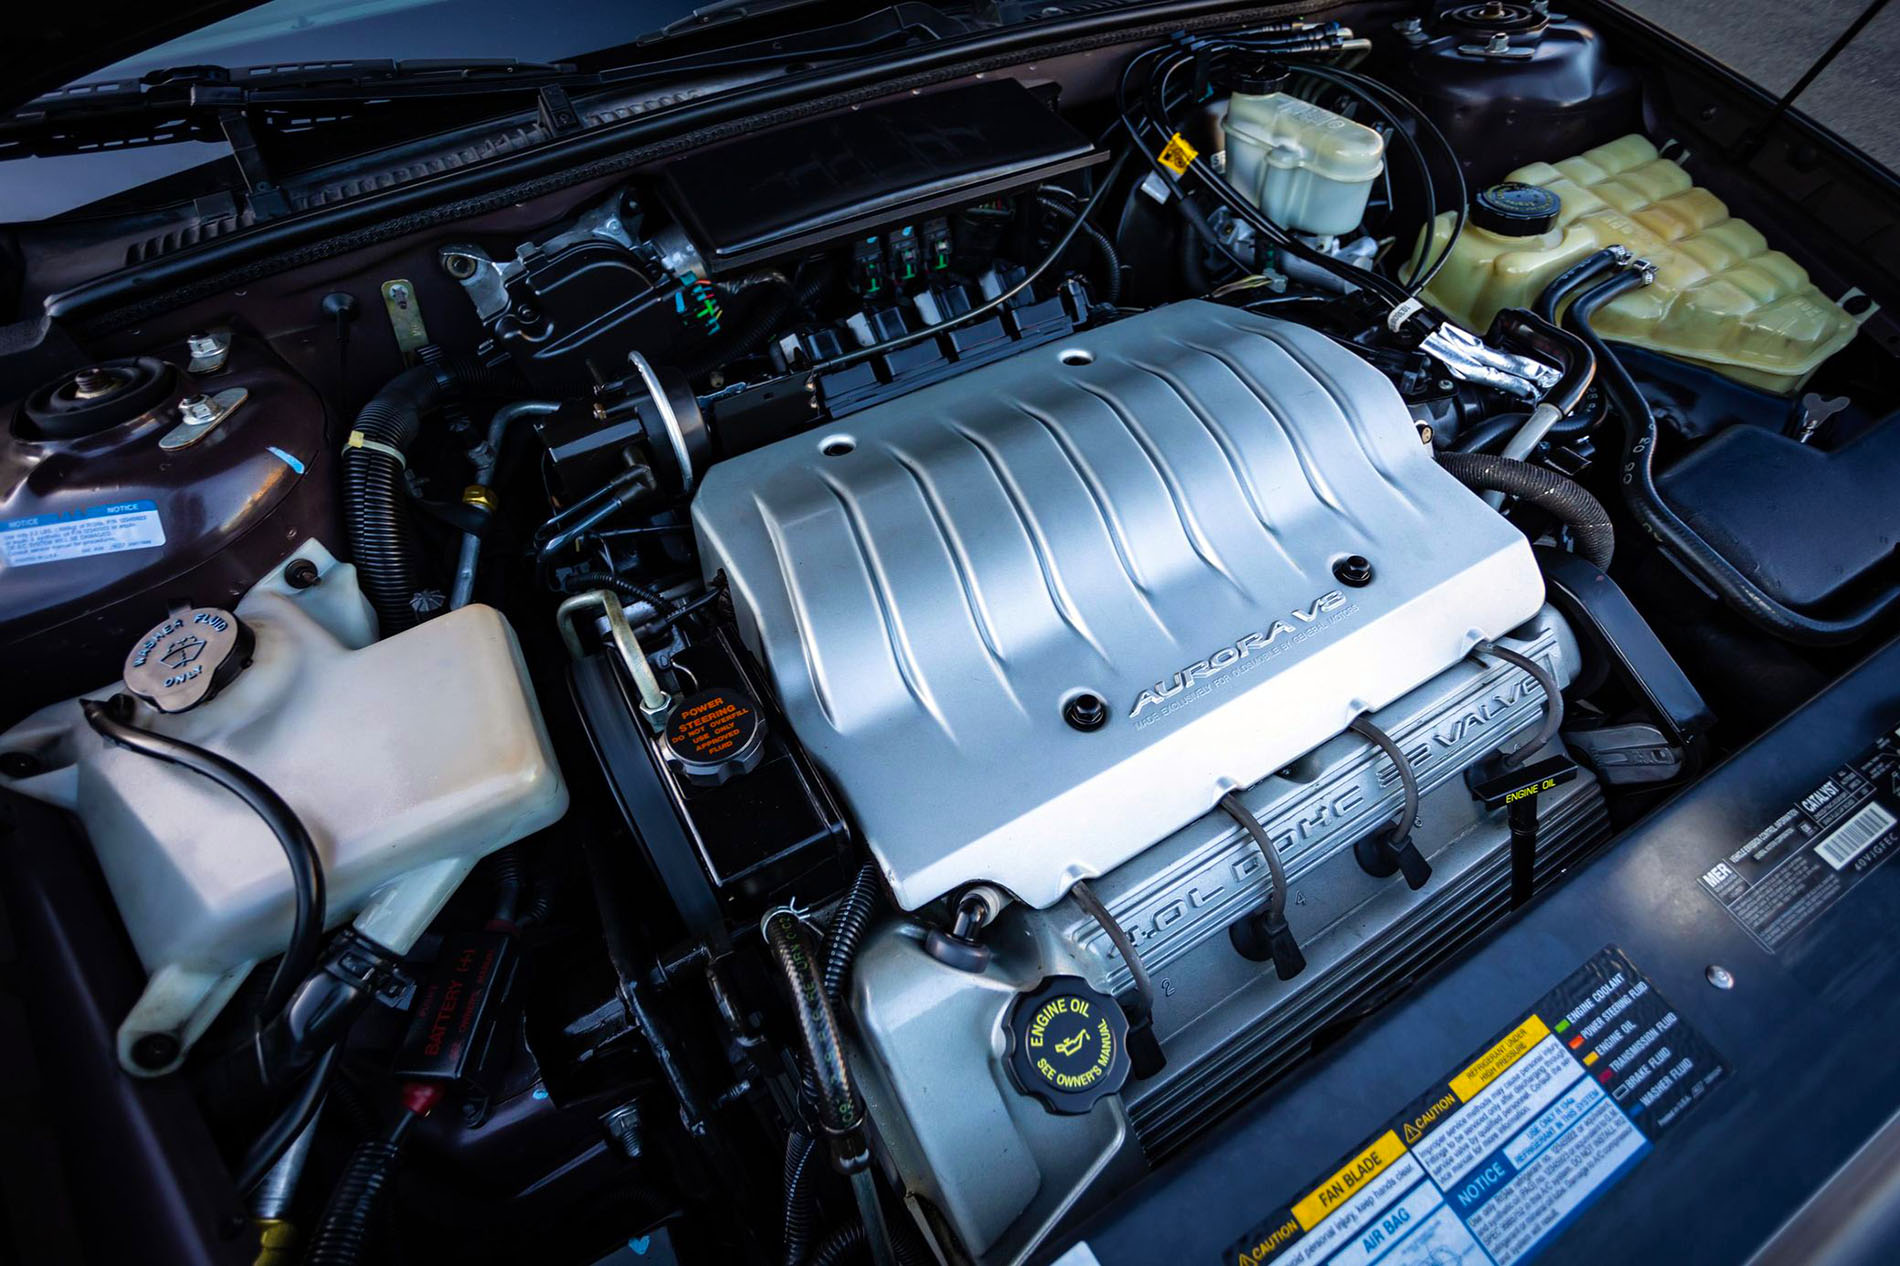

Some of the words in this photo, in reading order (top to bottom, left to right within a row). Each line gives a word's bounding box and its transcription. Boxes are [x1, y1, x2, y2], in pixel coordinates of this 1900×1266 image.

[8, 517, 38, 528] NOTICE
[106, 503, 138, 513] NOTICE
[133, 619, 184, 668] WASHER
[194, 613, 228, 632] FLUID
[1129, 619, 1297, 719] AURORA
[1292, 590, 1347, 623] V8
[164, 665, 202, 687] ONLY
[1135, 712, 1161, 732] MADE
[1160, 683, 1211, 717] EXCLUSIVELY
[1214, 674, 1230, 690] FOR
[1233, 647, 1281, 678] OLDSMOBILE
[1280, 639, 1293, 651] BY
[1293, 623, 1328, 646] GENERAL
[1328, 604, 1360, 627] MOTORS
[672, 735, 685, 743] DO
[688, 726, 705, 737] NOT
[710, 708, 749, 728] OVERFILL
[679, 705, 736, 732] STEERING
[681, 698, 723, 719] POWER
[693, 733, 710, 744] USE
[714, 722, 735, 734] ONLY
[696, 729, 740, 751] APPROVED
[709, 740, 733, 755] FLUID
[1505, 784, 1538, 804] ENGINE
[1542, 778, 1556, 790] OIL
[1801, 780, 1839, 812] CATALYST
[1232, 785, 1365, 882] DOHC
[1702, 860, 1733, 889] MER
[1295, 889, 1307, 906] 4
[1161, 978, 1176, 997] 2
[1565, 998, 1595, 1024] ENGINE
[1591, 971, 1626, 1002] COOLANT
[1580, 1016, 1605, 1040] POWER
[1601, 993, 1632, 1022] STEERING
[1627, 979, 1648, 999] FLUID
[422, 978, 465, 1059] BATTERY
[1030, 998, 1067, 1047] ENGINE
[1070, 998, 1090, 1018] OIL
[1594, 1029, 1624, 1056] ENGINE
[1619, 1017, 1636, 1034] OIL
[1037, 1058, 1057, 1081] SEE
[1056, 1065, 1102, 1088] OWNER'S
[1097, 1018, 1112, 1067] MANUAL
[1465, 1043, 1507, 1080] REFRIGERANT
[1504, 1027, 1527, 1047] UNDER
[1478, 1064, 1497, 1082] HIGH
[1494, 1040, 1527, 1069] PRESSURE
[1608, 1027, 1659, 1073] TRANSMISSION
[1655, 1011, 1677, 1032] FLUID
[1624, 1063, 1651, 1089] BRAKE
[1647, 1045, 1671, 1068] FLUID
[1638, 1074, 1673, 1107] WASHER
[1668, 1056, 1694, 1080] FLUID
[1413, 1092, 1456, 1130] CAUTION
[1417, 1132, 1448, 1160] Improper
[1444, 1116, 1467, 1137] service
[1464, 1095, 1492, 1120] methods
[1490, 1087, 1506, 1102] may
[1503, 1072, 1521, 1089] cause
[1518, 1052, 1545, 1077] personal
[1424, 1145, 1449, 1168] Fittings
[1446, 1139, 1455, 1149] to
[1453, 1132, 1464, 1143] be
[1461, 1111, 1488, 1136] serviced
[1485, 1101, 1502, 1117] only
[1498, 1090, 1514, 1105] after
[1512, 1064, 1547, 1095] discharging
[1543, 1047, 1567, 1069] through
[1432, 1155, 1455, 1176] service
[1453, 1142, 1470, 1158] valve
[1468, 1134, 1480, 1147] by
[1476, 1113, 1504, 1139] qualified
[1501, 1090, 1532, 1118] personnel.
[1529, 1071, 1552, 1092] Consult
[1549, 1063, 1561, 1075] the
[1512, 1125, 1557, 1165] REFRIGERANT
[1553, 1119, 1564, 1129] IN
[1561, 1107, 1577, 1123] THIS
[1574, 1087, 1600, 1111] SYSTEM
[1525, 1125, 1541, 1140] USE
[1538, 1111, 1557, 1128] ONLY
[1438, 1171, 1452, 1184] vice
[1450, 1151, 1474, 1173] manual
[1471, 1143, 1483, 1155] for
[1481, 1131, 1499, 1147] more
[1496, 1104, 1530, 1134] information.
[1579, 1143, 1595, 1158] NOT
[1316, 1180, 1345, 1207] FAN
[1340, 1150, 1383, 1188] BLADE
[1456, 1161, 1506, 1207] NOTICE
[1302, 1226, 1337, 1258] personal
[1333, 1209, 1358, 1232] injury,
[1354, 1194, 1376, 1214] keep
[1371, 1176, 1397, 1199] hands
[1393, 1162, 1414, 1181] clear.
[1359, 1228, 1385, 1253] AIR
[1381, 1206, 1412, 1235] BAG
[1249, 1218, 1300, 1262] CAUTION
